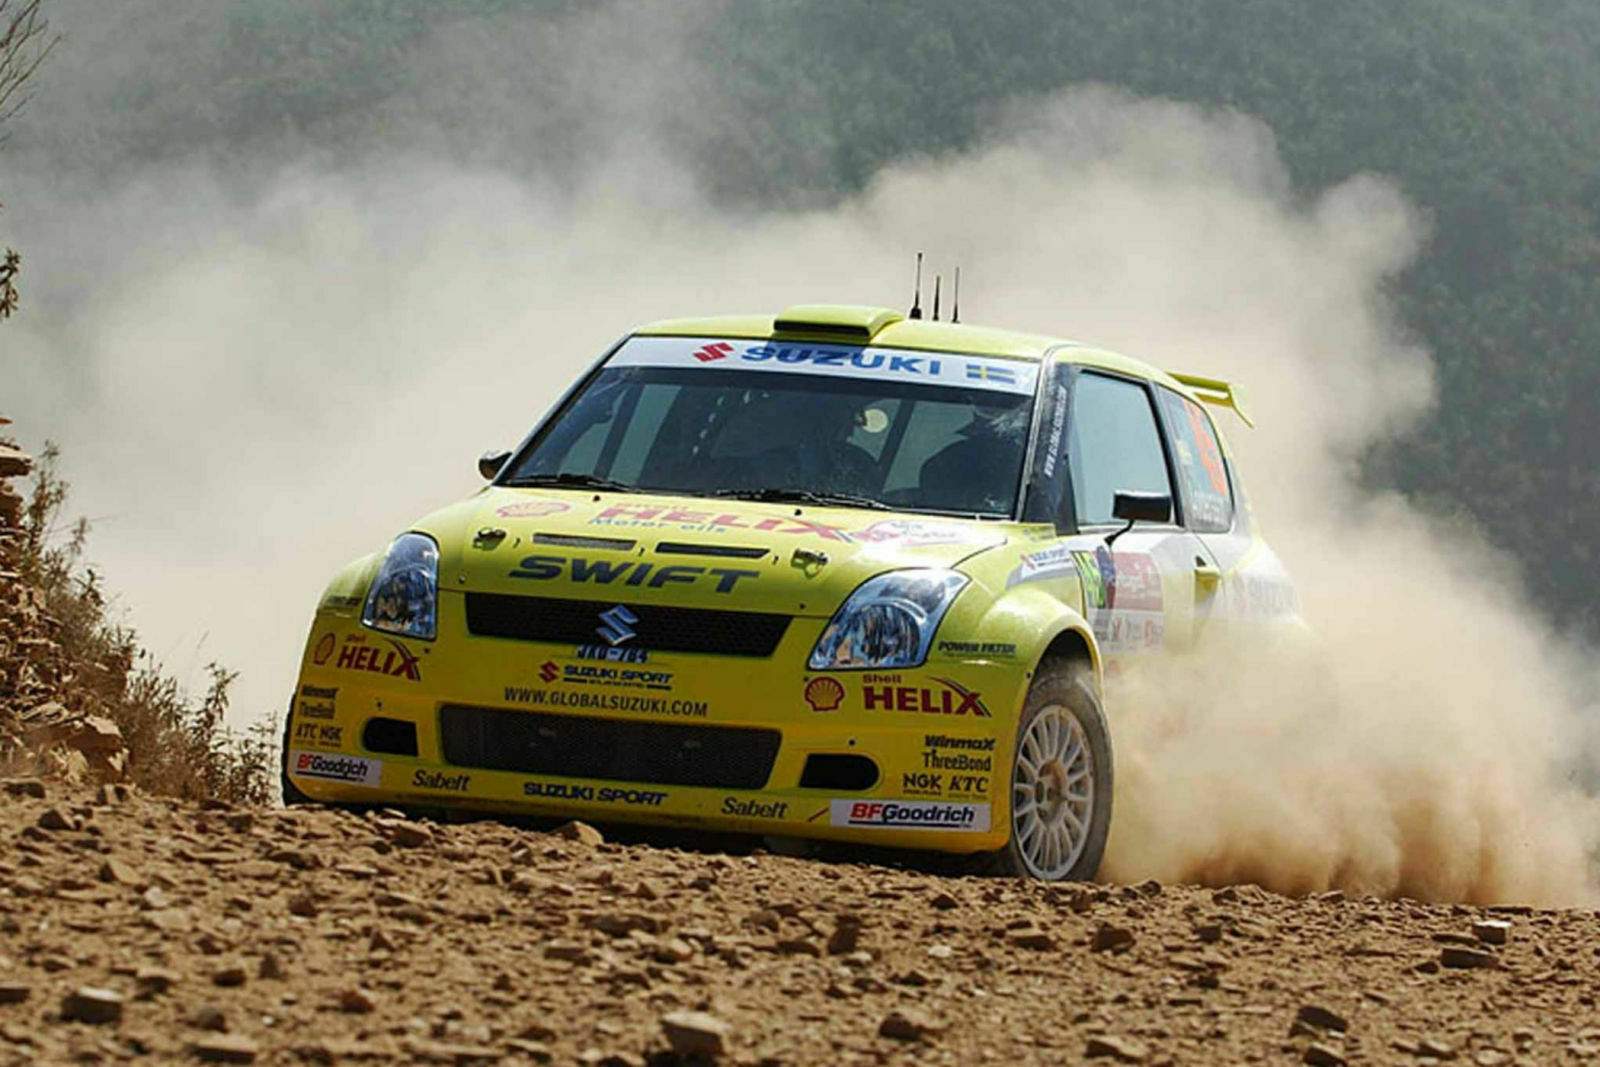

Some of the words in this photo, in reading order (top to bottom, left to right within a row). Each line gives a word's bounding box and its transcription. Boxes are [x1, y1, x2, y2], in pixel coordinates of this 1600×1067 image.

[741, 345, 940, 376] SUZUKI
[593, 506, 854, 544] HELIX
[508, 555, 760, 594] SWIFT
[336, 642, 421, 681] HELIX
[564, 665, 617, 680] SUZUKI
[620, 669, 674, 684] SPORT
[862, 673, 902, 684] Shell
[504, 686, 708, 718] WWW.GLOBALSUZUKI.COM
[863, 678, 992, 718] HELIX
[924, 734, 995, 751] Winmax
[921, 748, 992, 772] ThreeBond
[524, 781, 593, 802] SUZUKI
[596, 785, 669, 807] SPORT
[902, 772, 943, 790] NGK
[948, 775, 990, 793] KTC
[850, 802, 975, 823] BFGoodrich
